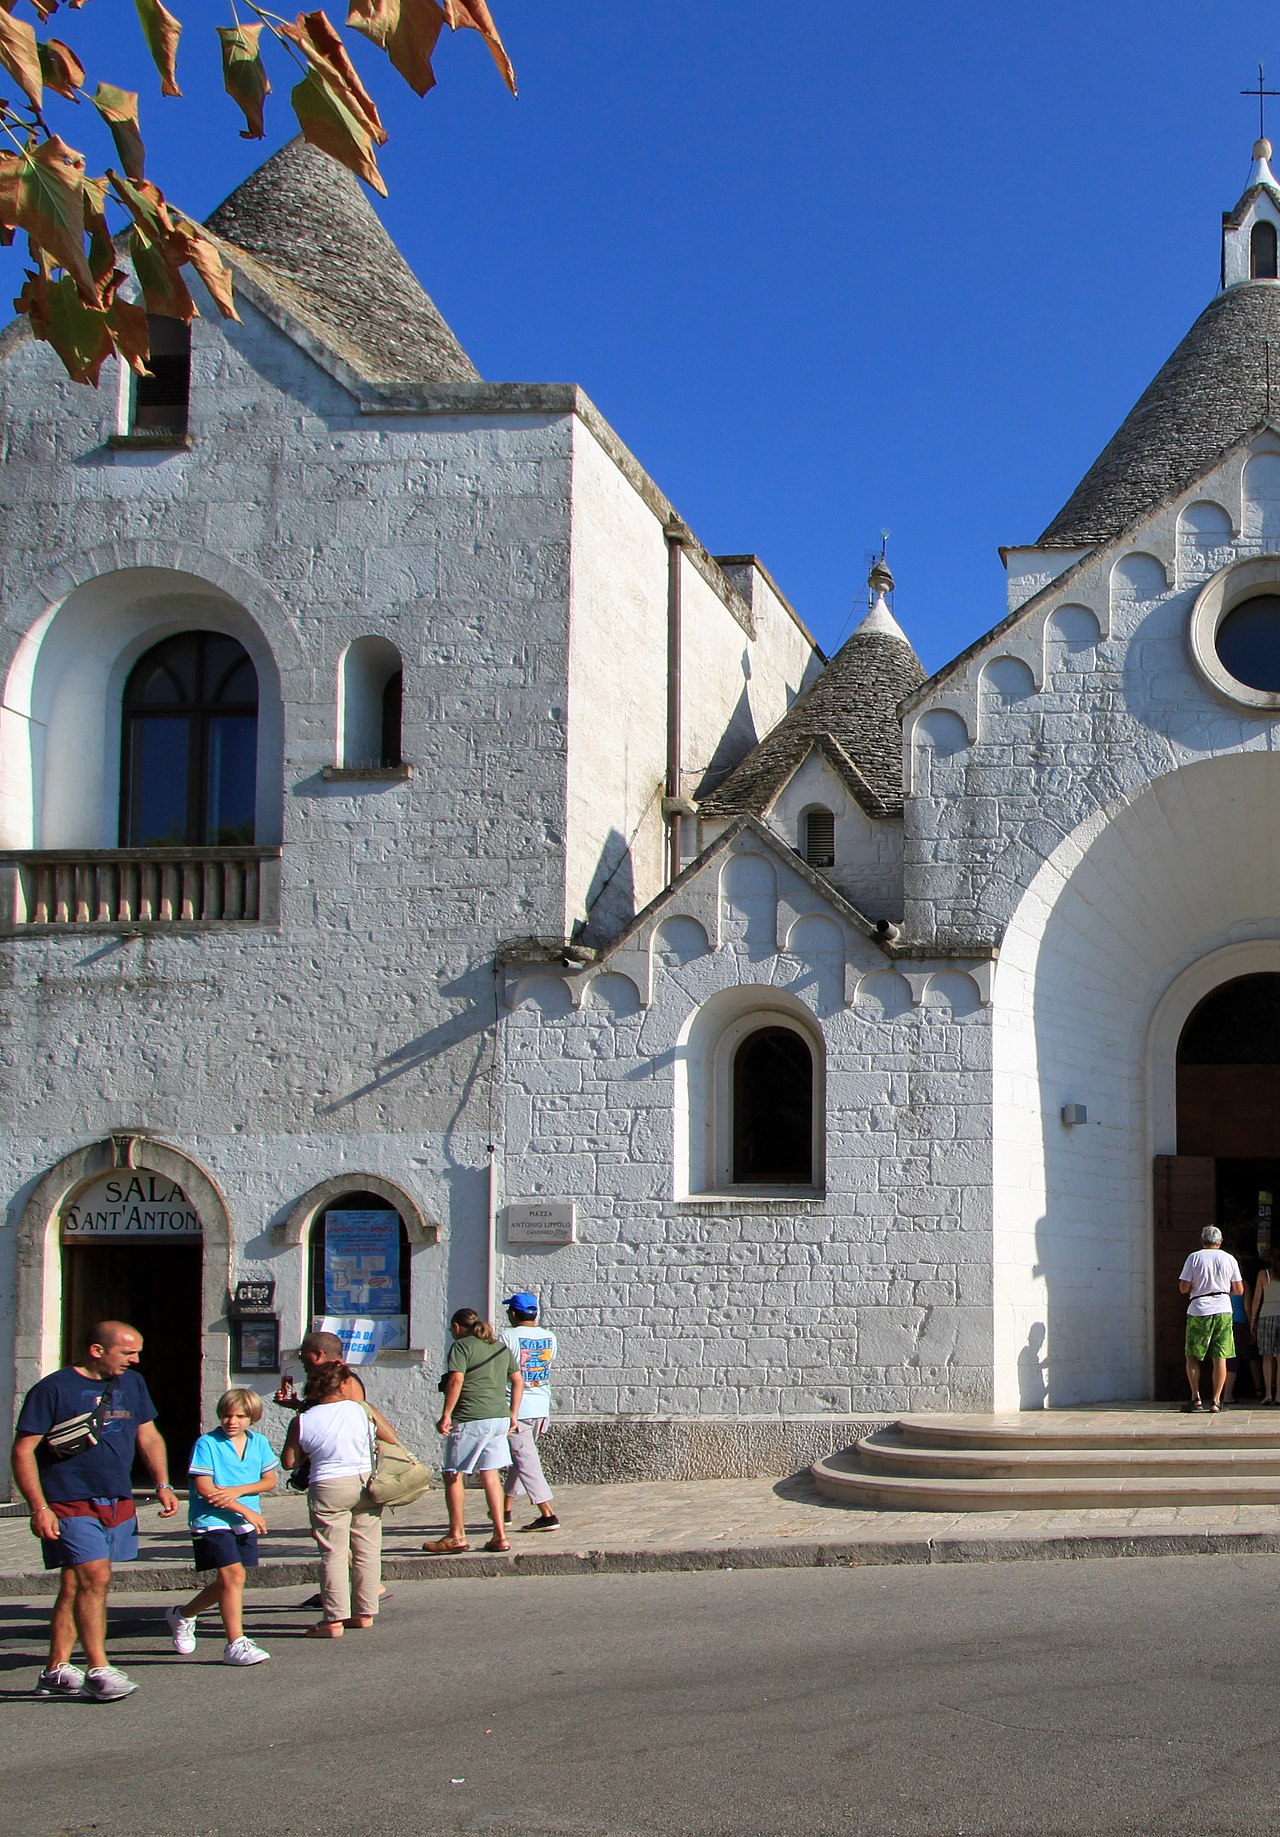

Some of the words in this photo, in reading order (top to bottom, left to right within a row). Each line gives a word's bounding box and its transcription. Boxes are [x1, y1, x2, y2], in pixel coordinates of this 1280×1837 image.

[106, 1177, 186, 1203] SALA
[337, 1329, 361, 1339] PESCA
[362, 1331, 374, 1341] DI
